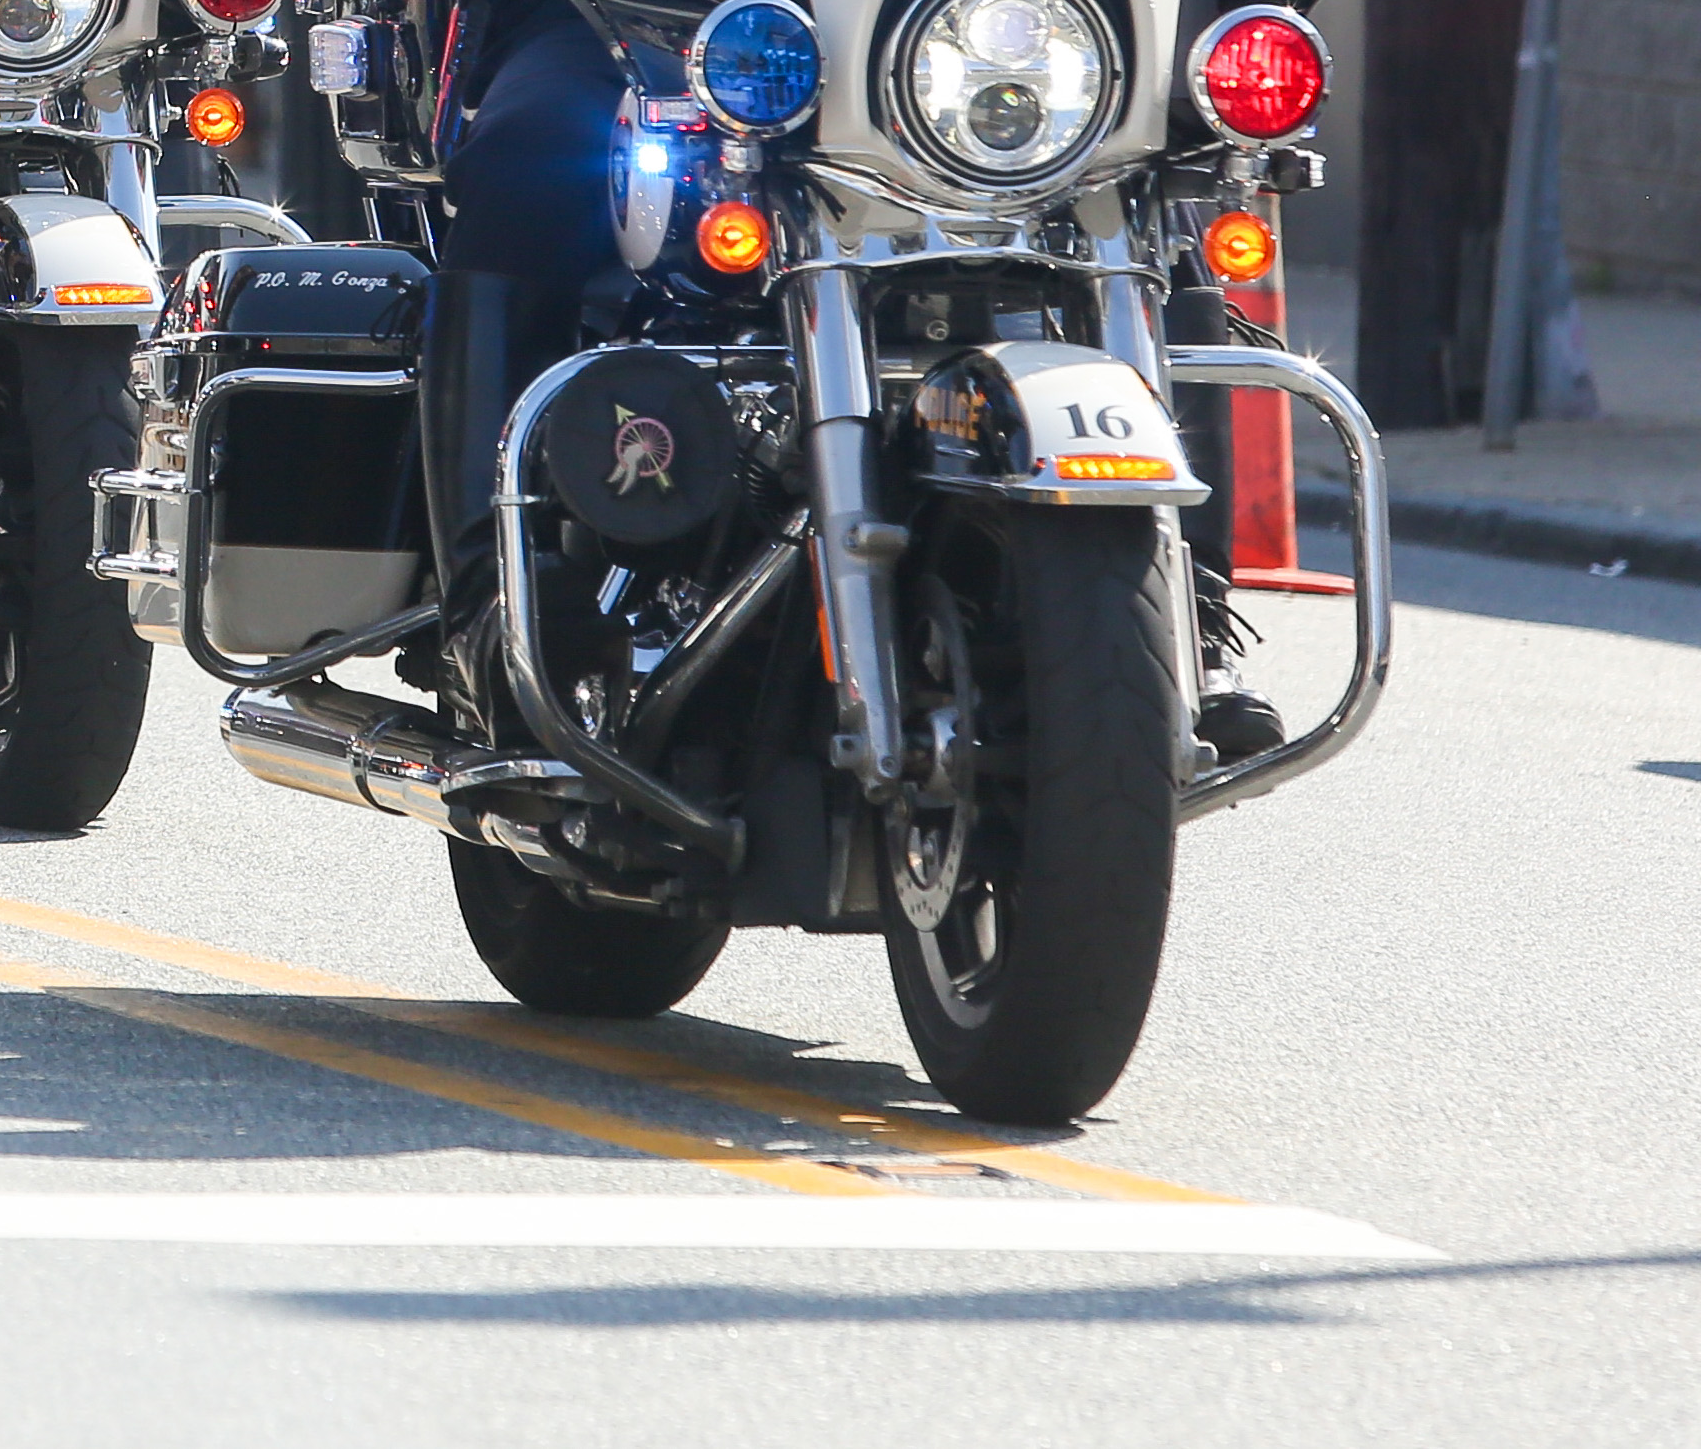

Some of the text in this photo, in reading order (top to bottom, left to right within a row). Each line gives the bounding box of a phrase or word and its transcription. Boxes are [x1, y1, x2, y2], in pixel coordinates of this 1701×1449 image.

[254, 271, 411, 294] P.O. M. Gonza
[1057, 403, 1134, 440] 16
